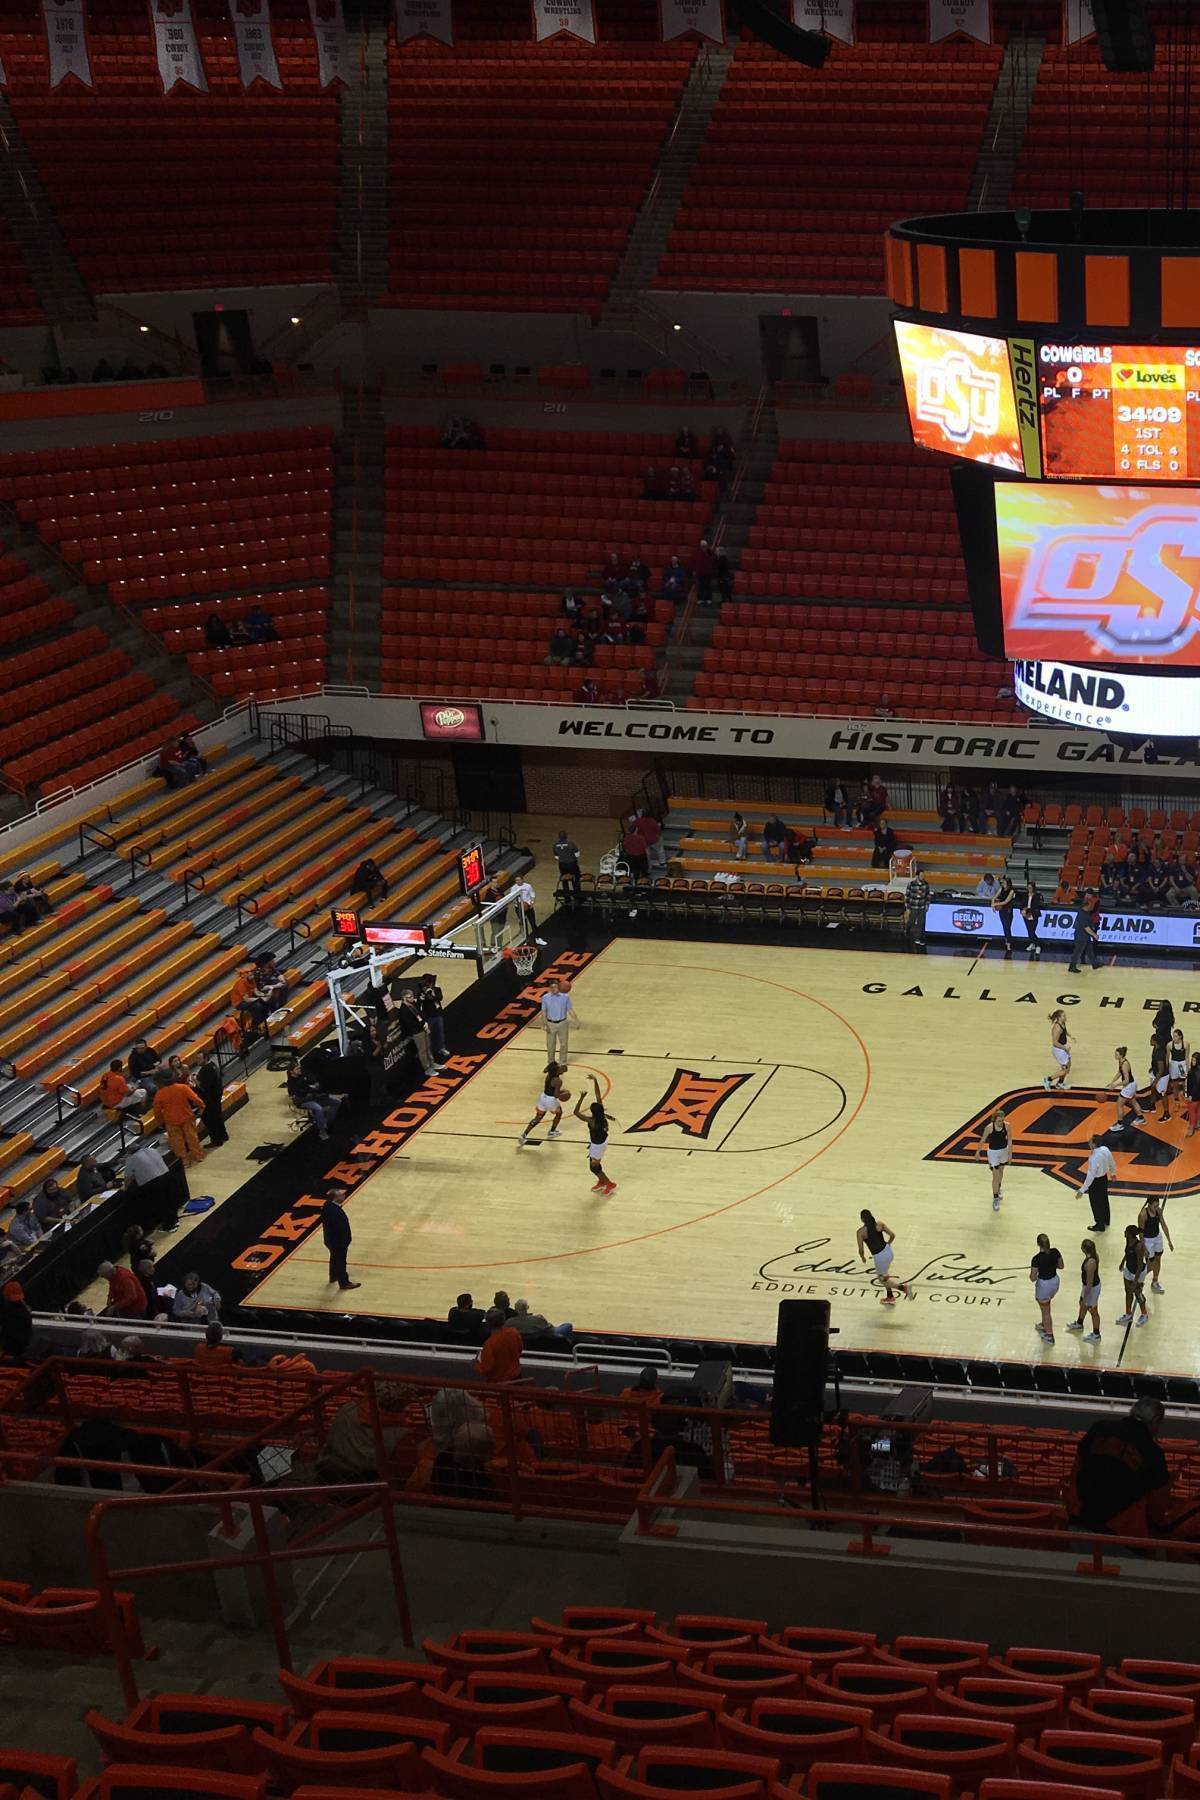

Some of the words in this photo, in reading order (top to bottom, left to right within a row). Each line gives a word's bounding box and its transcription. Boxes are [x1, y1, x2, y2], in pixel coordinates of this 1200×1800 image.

[1040, 345, 1112, 364] COWGIRLS
[1067, 366, 1083, 382] 0
[1012, 343, 1037, 429] Hertz
[1043, 387, 1061, 398] PL
[1071, 388, 1081, 398] F
[1092, 389, 1111, 399] PT
[917, 350, 1000, 444] OSU
[138, 409, 174, 423] 210
[1117, 406, 1182, 423] 34:09
[1135, 428, 1161, 439] 1ST
[1137, 444, 1164, 456] TOL
[1120, 459, 1130, 470] 0
[1136, 459, 1161, 471] FLS
[1169, 460, 1179, 471] 0
[558, 719, 719, 742] WELCOME
[730, 727, 774, 745] TO
[830, 730, 1041, 759] HISTORIC
[953, 912, 984, 922] BEDLAM
[476, 951, 593, 1040] STATE
[751, 1281, 818, 1295] EDDIE
[928, 1292, 1006, 1307] COURT
